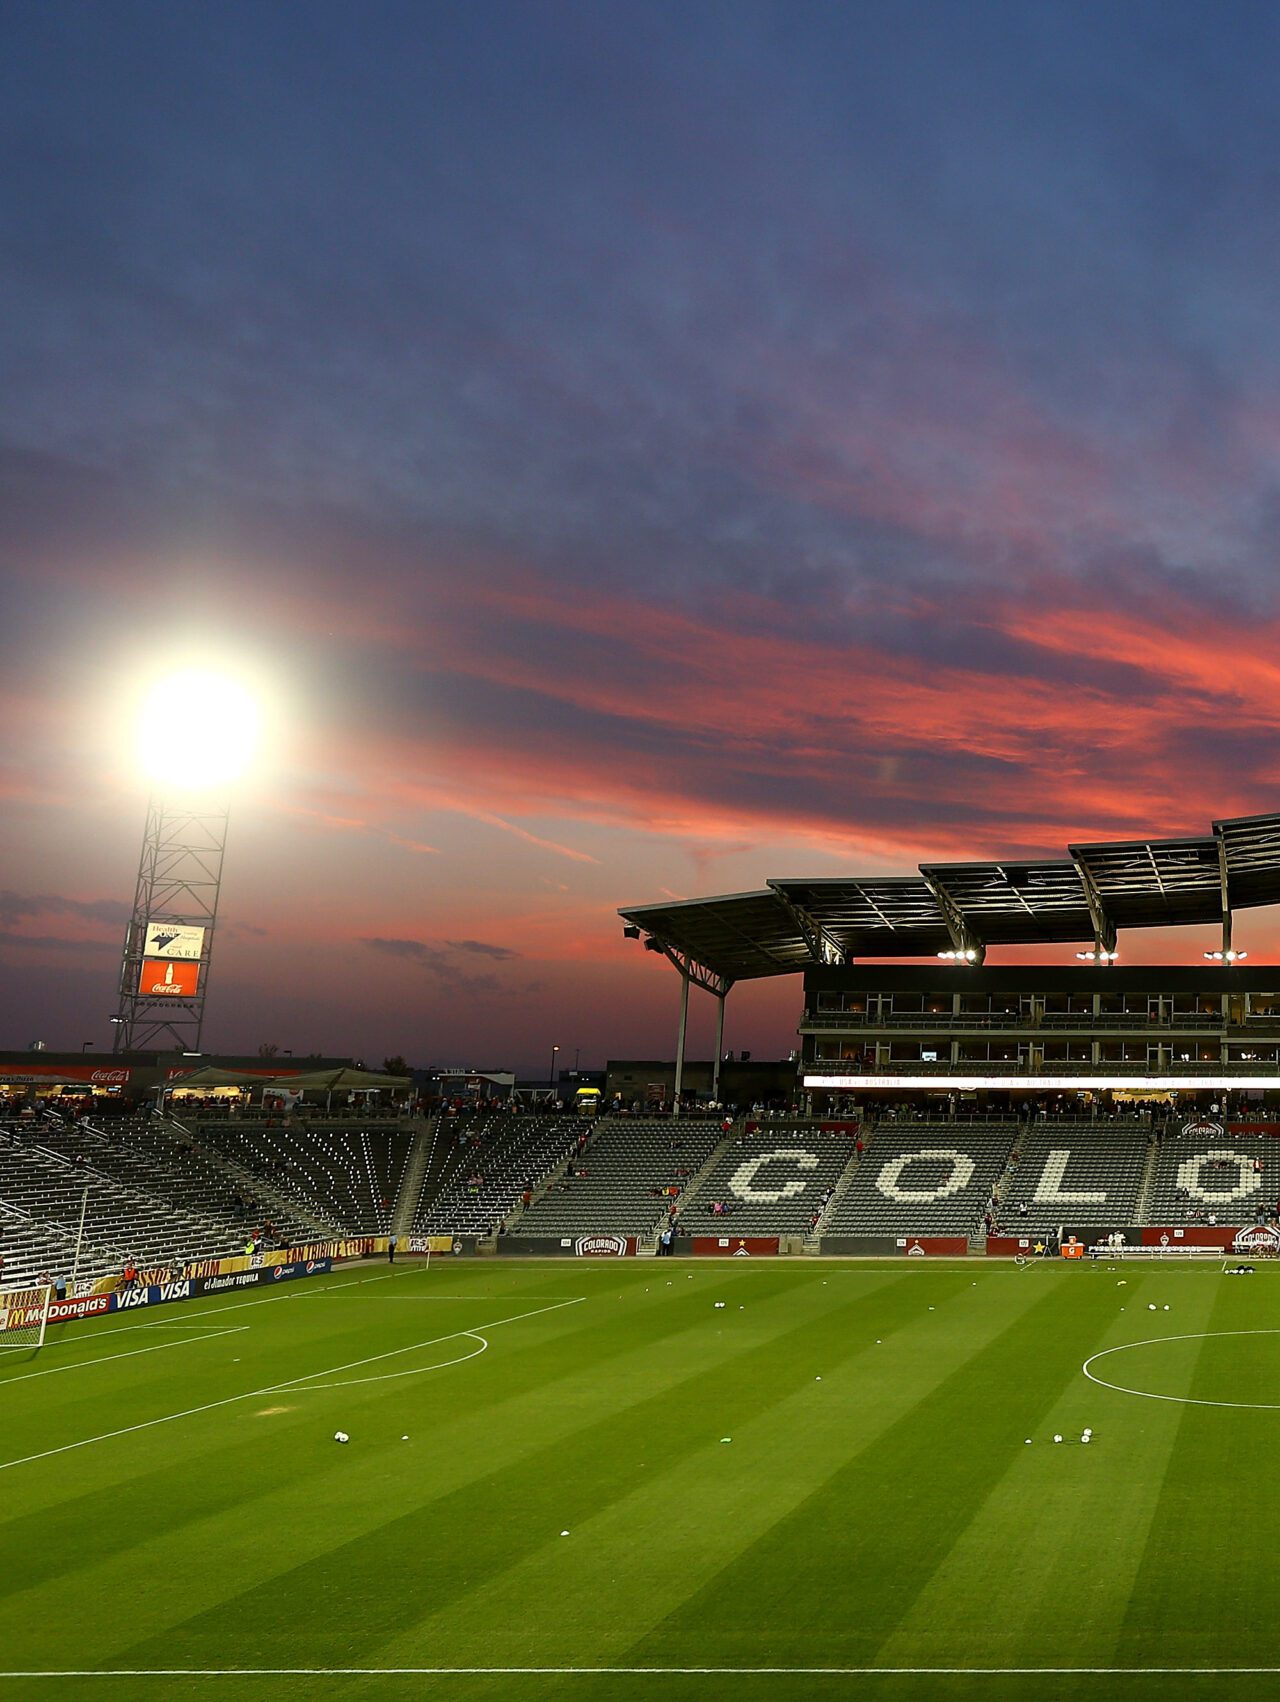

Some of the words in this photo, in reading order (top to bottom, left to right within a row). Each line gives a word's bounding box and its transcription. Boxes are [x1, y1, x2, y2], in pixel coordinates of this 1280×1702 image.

[167, 948, 198, 957] CARE
[584, 1238, 618, 1252] COLORADO
[116, 1288, 148, 1309] VISA
[160, 1280, 190, 1301] VISA
[25, 1298, 107, 1323] McDonald's
